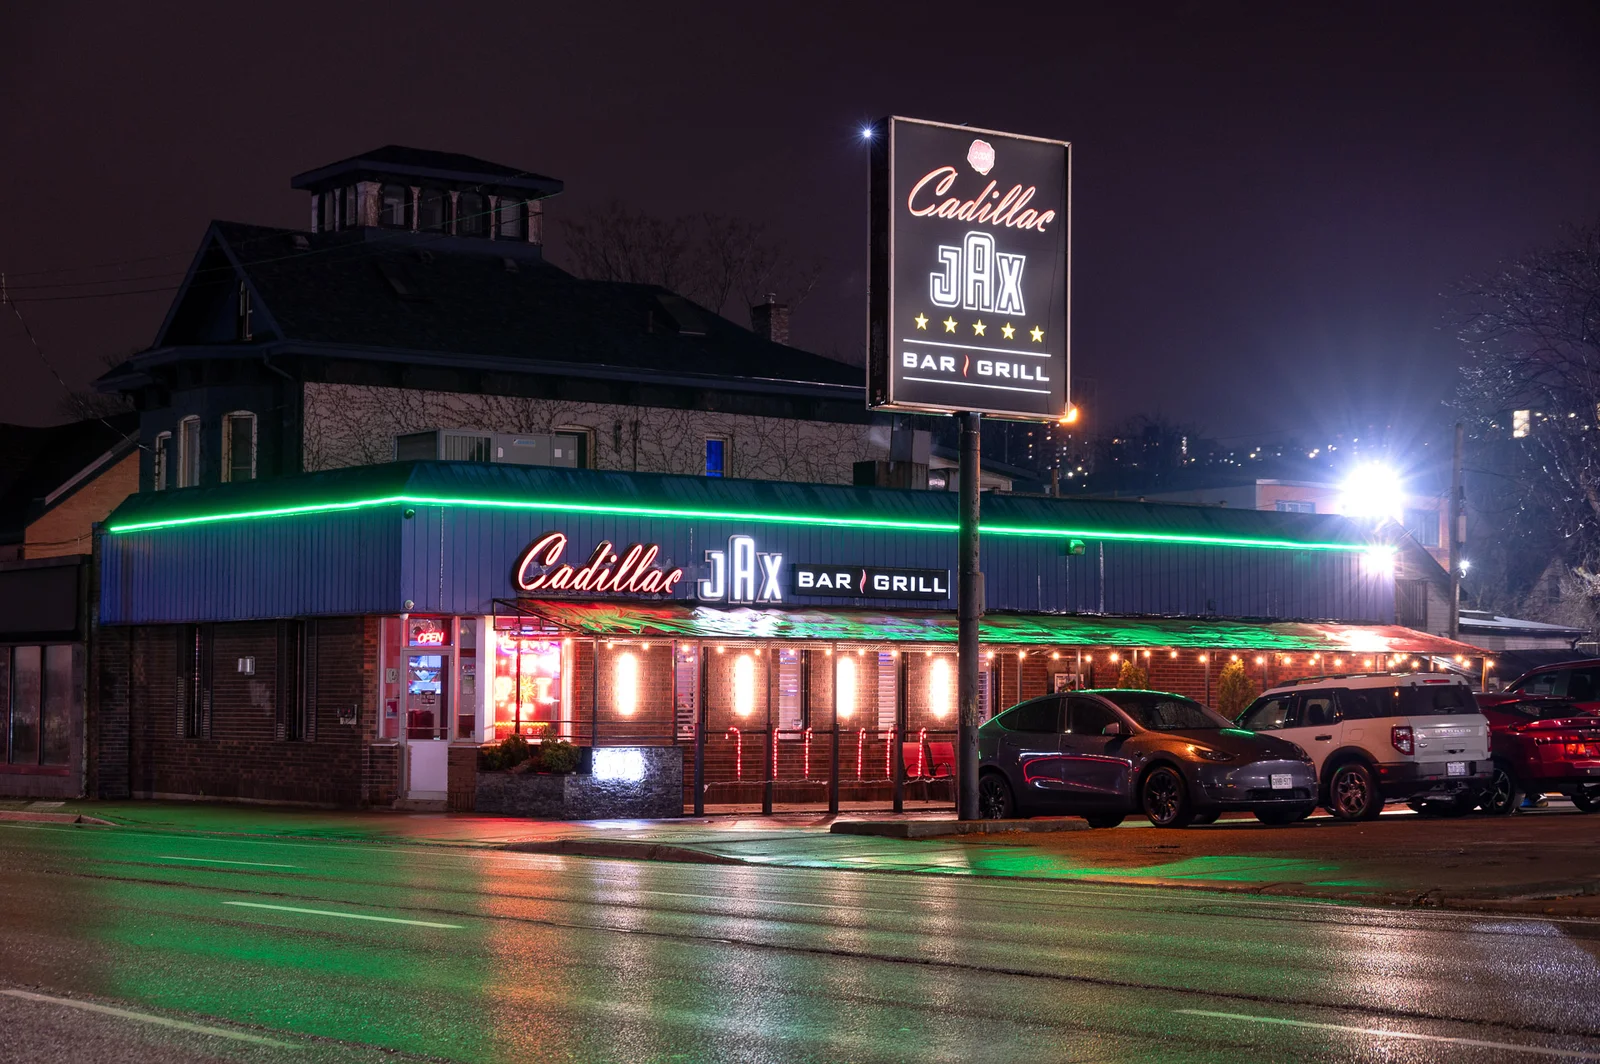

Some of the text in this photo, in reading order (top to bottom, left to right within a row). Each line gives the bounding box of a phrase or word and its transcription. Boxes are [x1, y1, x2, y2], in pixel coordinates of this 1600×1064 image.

[907, 166, 1055, 232] Cadillac
[930, 231, 1026, 316] JAX
[903, 352, 1050, 382] BAR GRILL
[515, 532, 947, 604] Cadillac JAX BAR GRILL
[417, 632, 444, 644] OPEN
